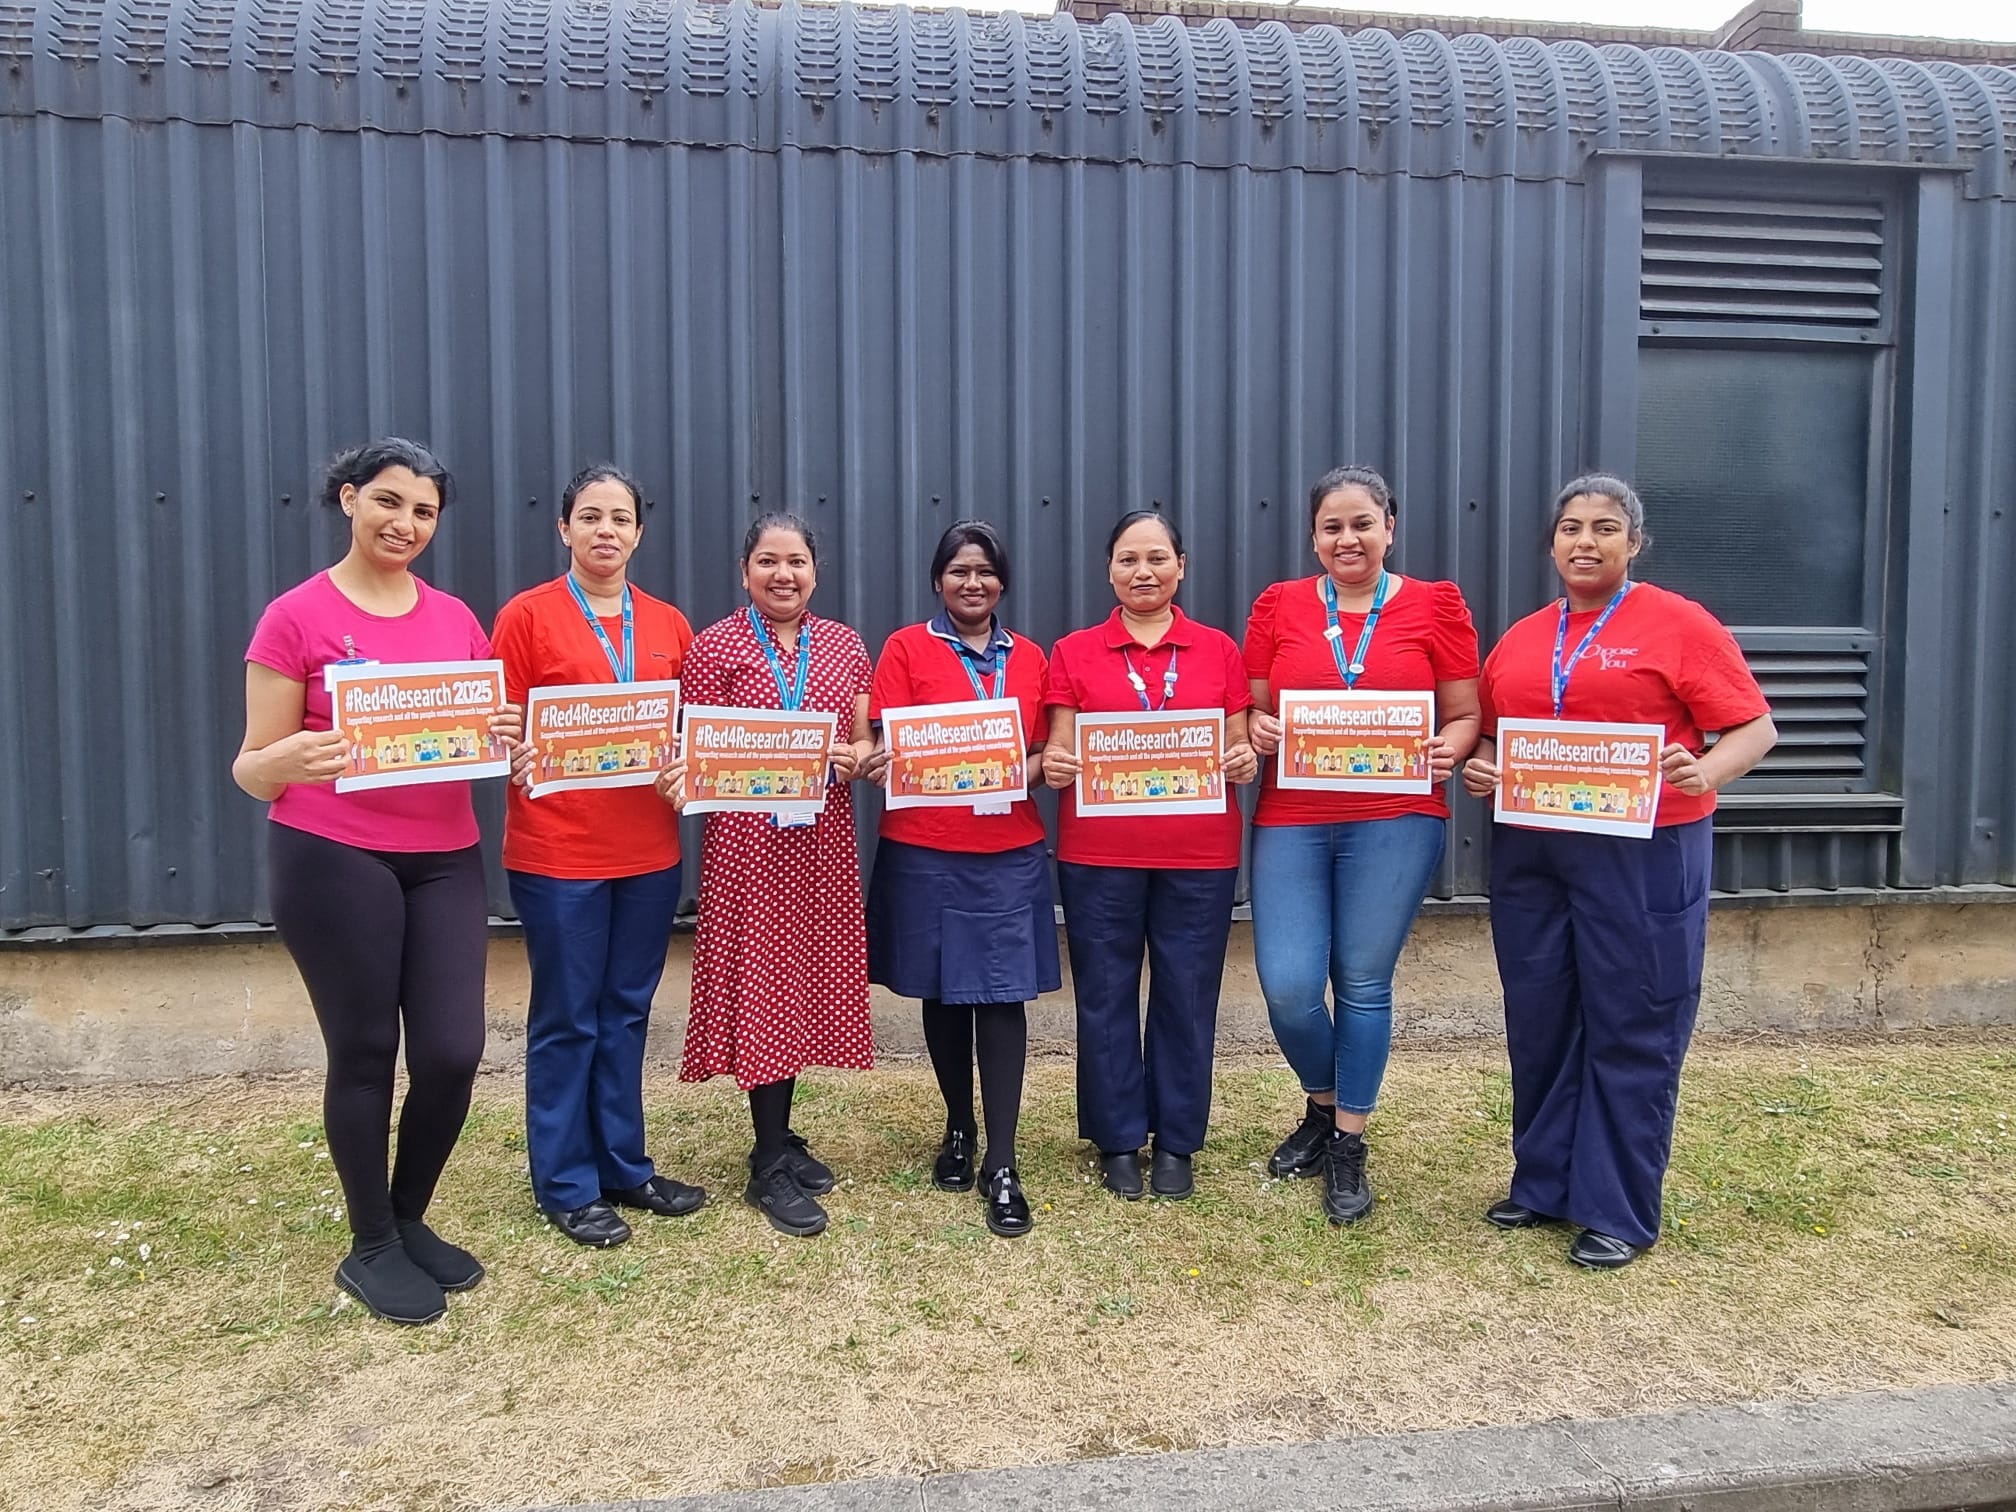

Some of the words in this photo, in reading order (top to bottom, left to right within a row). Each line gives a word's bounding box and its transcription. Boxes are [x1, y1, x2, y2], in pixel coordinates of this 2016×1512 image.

[1600, 652, 1627, 670] You
[345, 681, 450, 713] #Red4Research
[452, 680, 493, 704] 2025
[540, 700, 634, 728] #Red4Research
[635, 698, 668, 720] 2025
[1293, 705, 1385, 725] #Red4Research
[1387, 706, 1422, 726] 2025
[695, 724, 789, 749] #Red4Research
[790, 728, 824, 750] 2025
[898, 720, 982, 747] #Red4Research
[983, 717, 1013, 739] 2025
[1088, 728, 1178, 752] #Red4Research
[1180, 726, 1213, 748] 2025
[1510, 736, 1608, 763] #Red4Research
[1610, 742, 1650, 765] 2025
